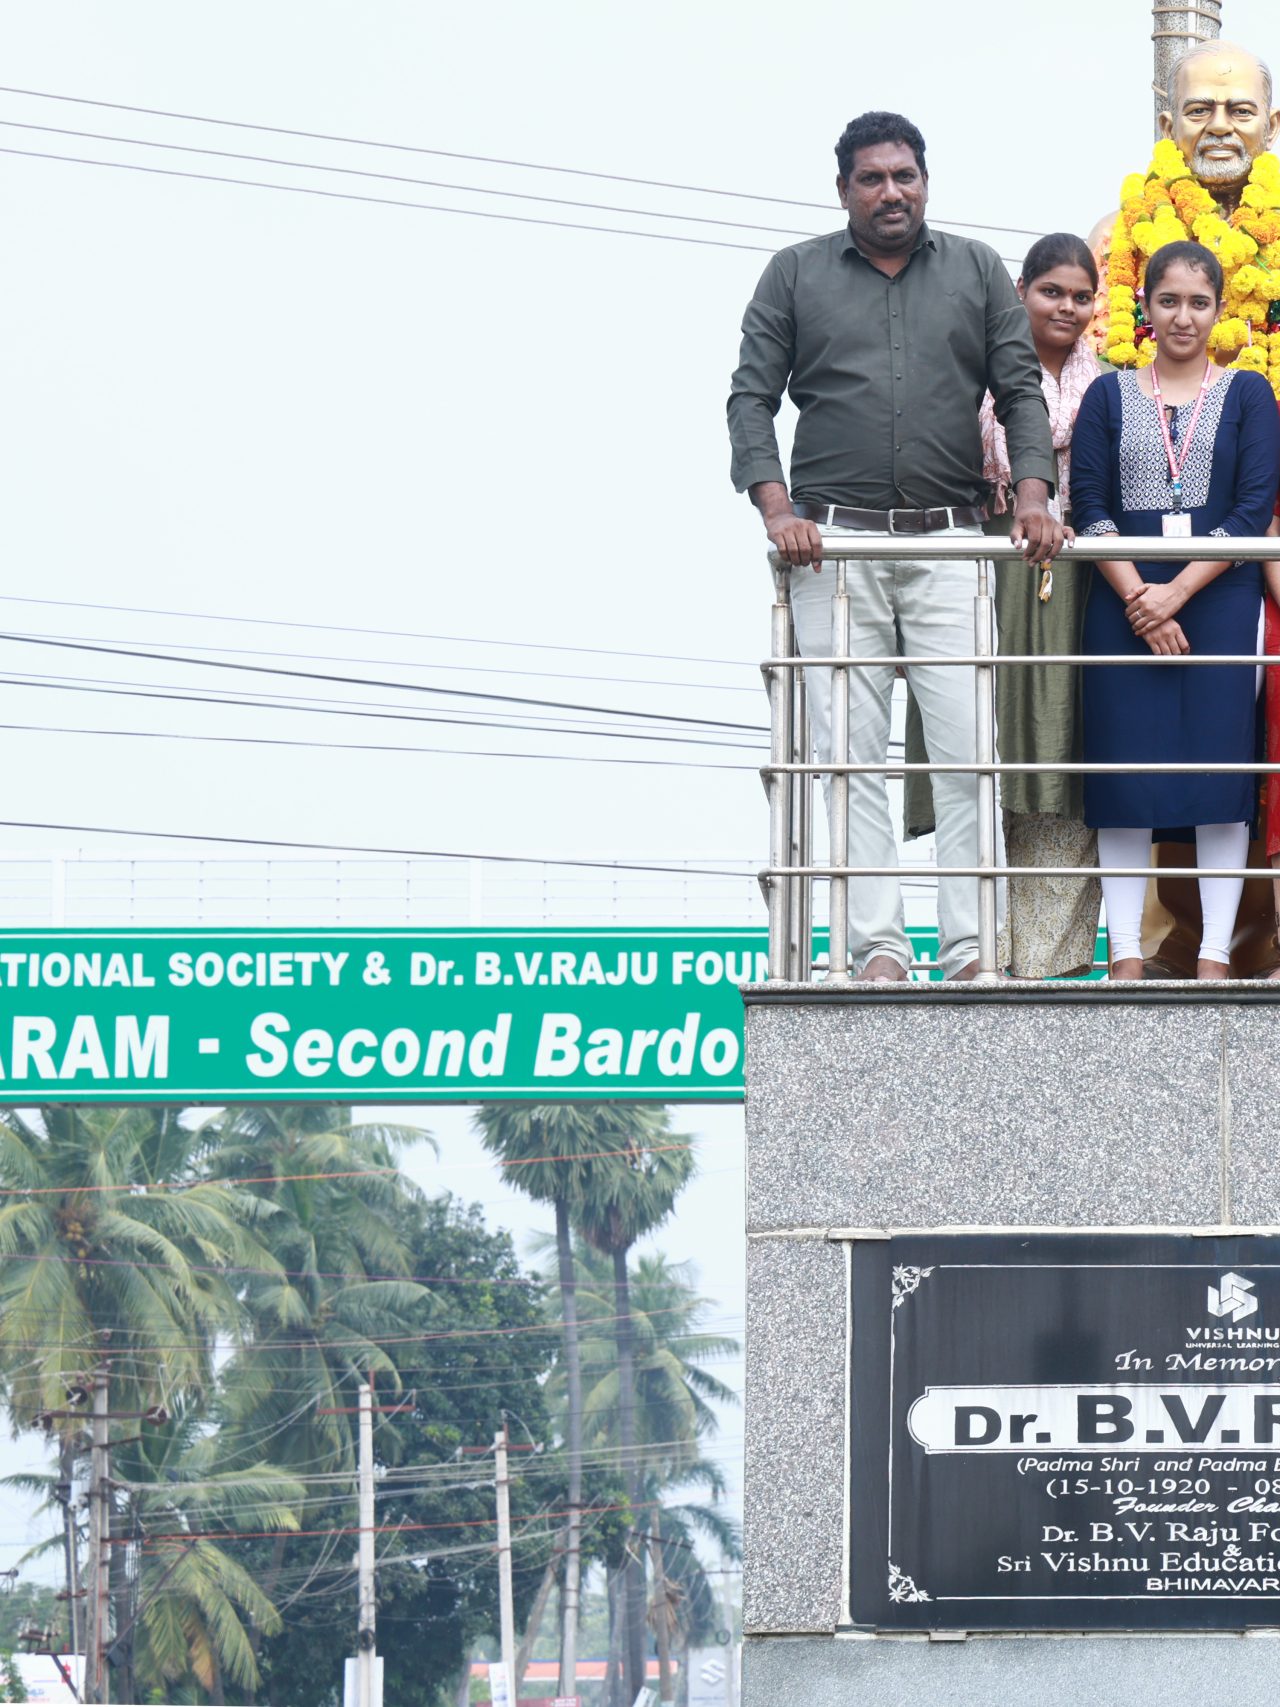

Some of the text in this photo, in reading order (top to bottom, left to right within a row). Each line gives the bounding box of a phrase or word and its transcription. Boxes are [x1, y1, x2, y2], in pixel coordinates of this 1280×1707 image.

[0, 952, 156, 987] TIONAL
[168, 951, 350, 987] SOCIETY
[362, 951, 392, 986] &
[410, 952, 464, 986] Dr.
[475, 951, 658, 986] B.V.RAJU
[0, 1012, 743, 1080] RAM - Second Bardo
[1186, 1327, 1280, 1341] VISHNU
[1115, 1348, 1155, 1371] In
[954, 1405, 1051, 1446] Dr.
[1016, 1457, 1094, 1476] (Padma
[1099, 1457, 1141, 1472] Shri
[1153, 1457, 1194, 1472] and
[1197, 1457, 1268, 1472] Padma
[1046, 1478, 1211, 1499] (15-10-1920
[1112, 1496, 1220, 1516] Founder
[1041, 1525, 1079, 1543] Dr.
[1089, 1522, 1156, 1543] B.V.
[1164, 1520, 1241, 1547] Raju
[1222, 1543, 1242, 1557] &
[997, 1555, 1032, 1573] Sri
[1040, 1552, 1151, 1573] Vishnu
